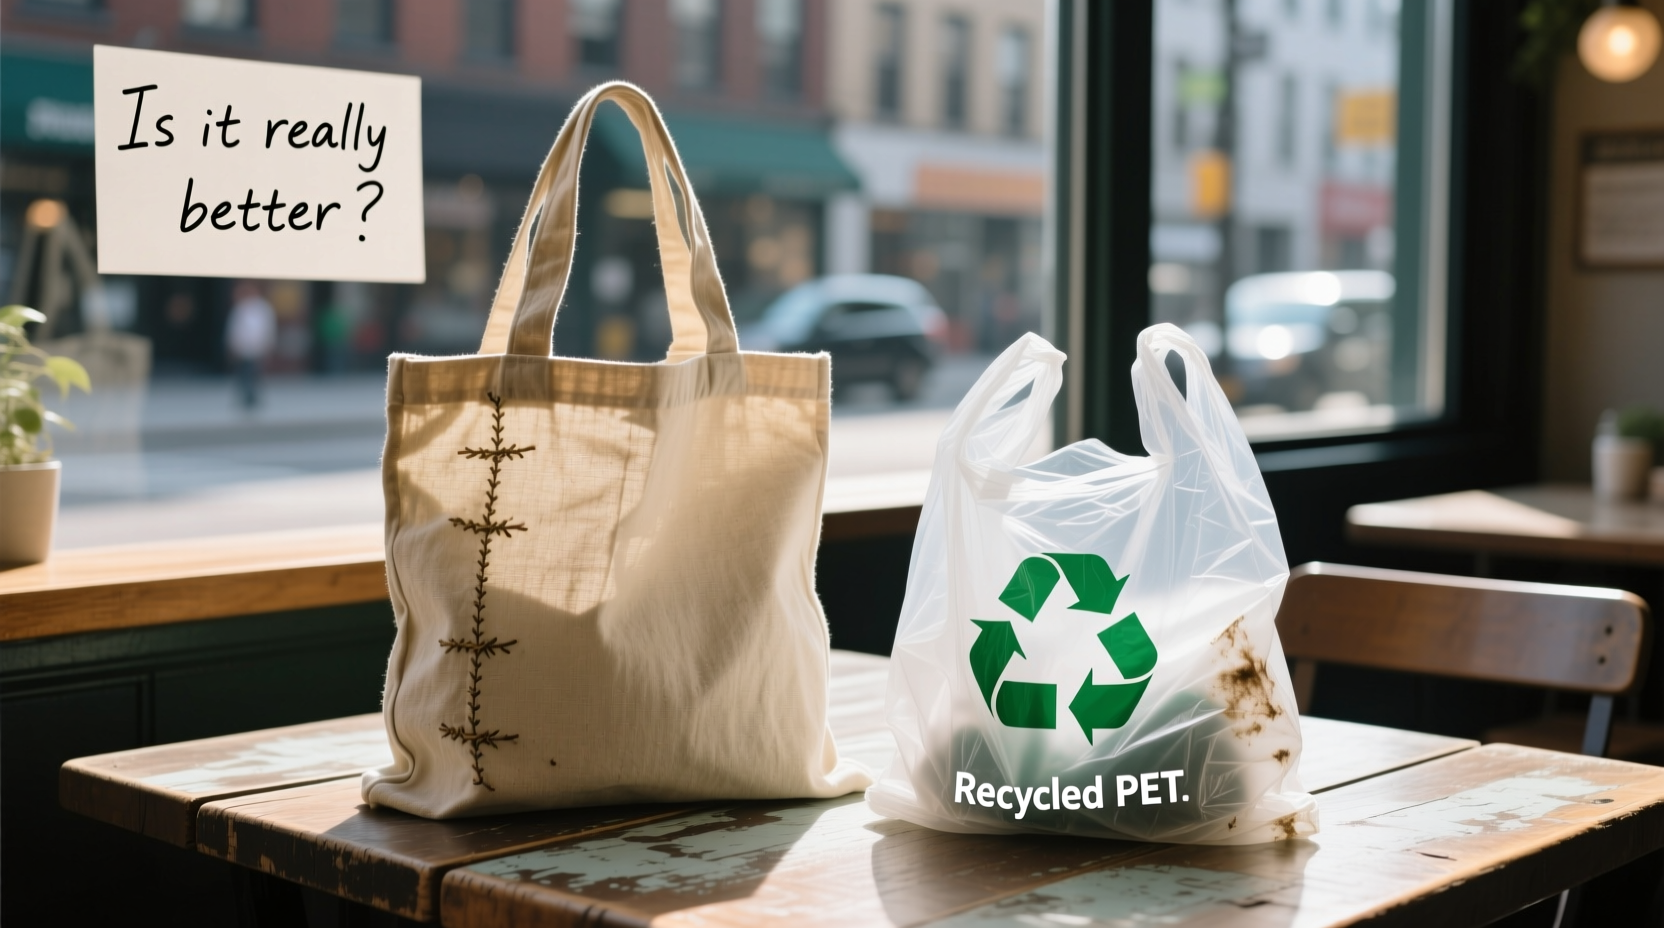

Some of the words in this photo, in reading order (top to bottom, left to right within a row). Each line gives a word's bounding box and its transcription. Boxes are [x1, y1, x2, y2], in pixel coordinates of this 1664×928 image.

[117, 84, 175, 151] Is
[202, 104, 241, 149] it
[265, 102, 387, 173] really
[954, 771, 1104, 820] Recycled
[1116, 769, 1190, 807] PET.
